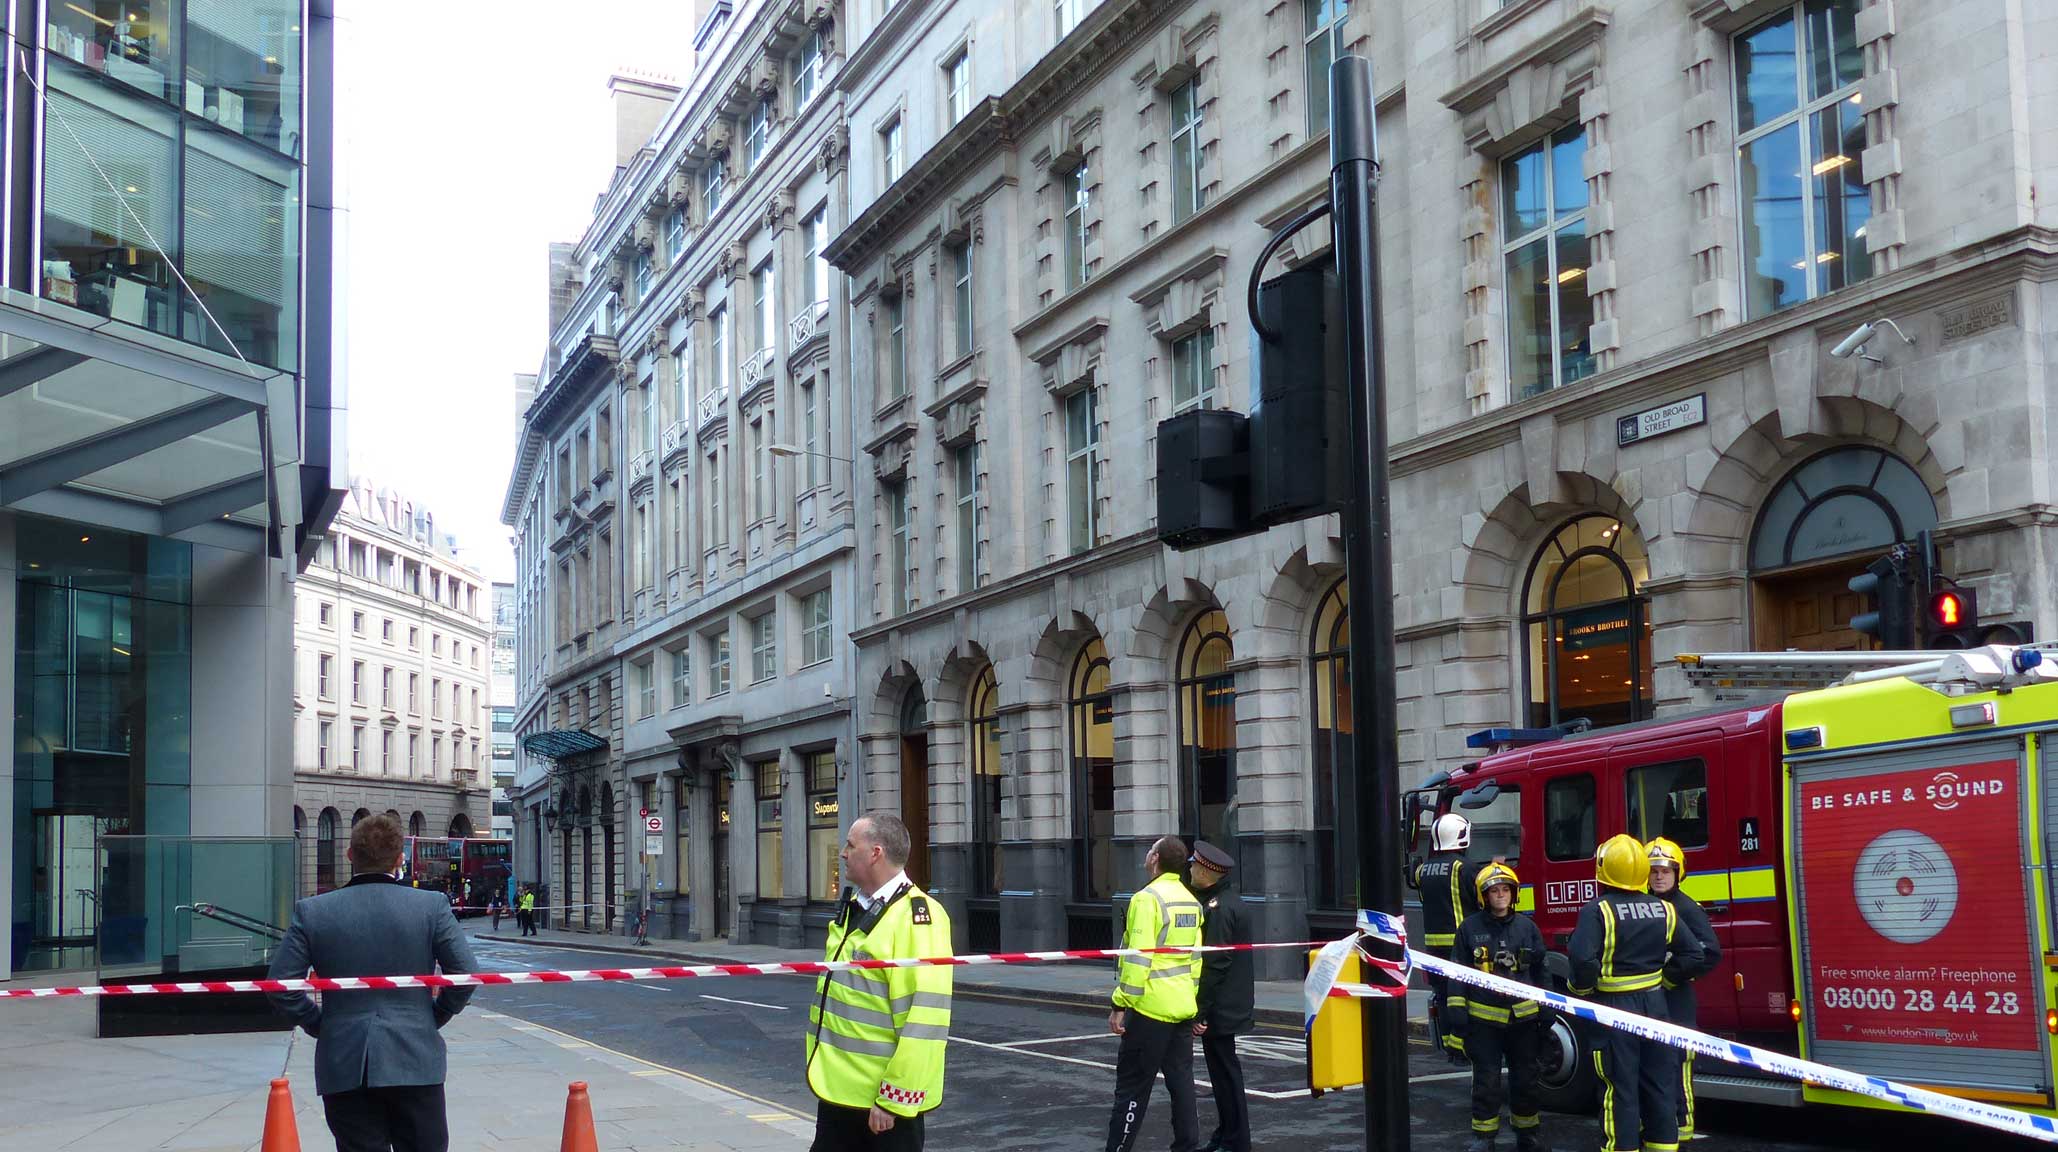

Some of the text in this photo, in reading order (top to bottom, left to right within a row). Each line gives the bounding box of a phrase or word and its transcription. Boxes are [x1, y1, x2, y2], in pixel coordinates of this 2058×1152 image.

[1644, 403, 1690, 423] OLD BROAD
[1644, 419, 1672, 433] STREET
[1811, 779, 2004, 810] BE SAFE & SOUND
[1745, 822, 1753, 835] A
[1741, 837, 1759, 851] 281
[1421, 862, 1449, 876] FIRE
[1615, 902, 1666, 920] FIRE
[1176, 914, 1197, 928] POLICE
[1821, 965, 2017, 985] Free smoke alarm? Freephone
[1823, 986, 2019, 1015] 08000 28 44 28
[1861, 1025, 1979, 1043] www.london-fire.gov.uk
